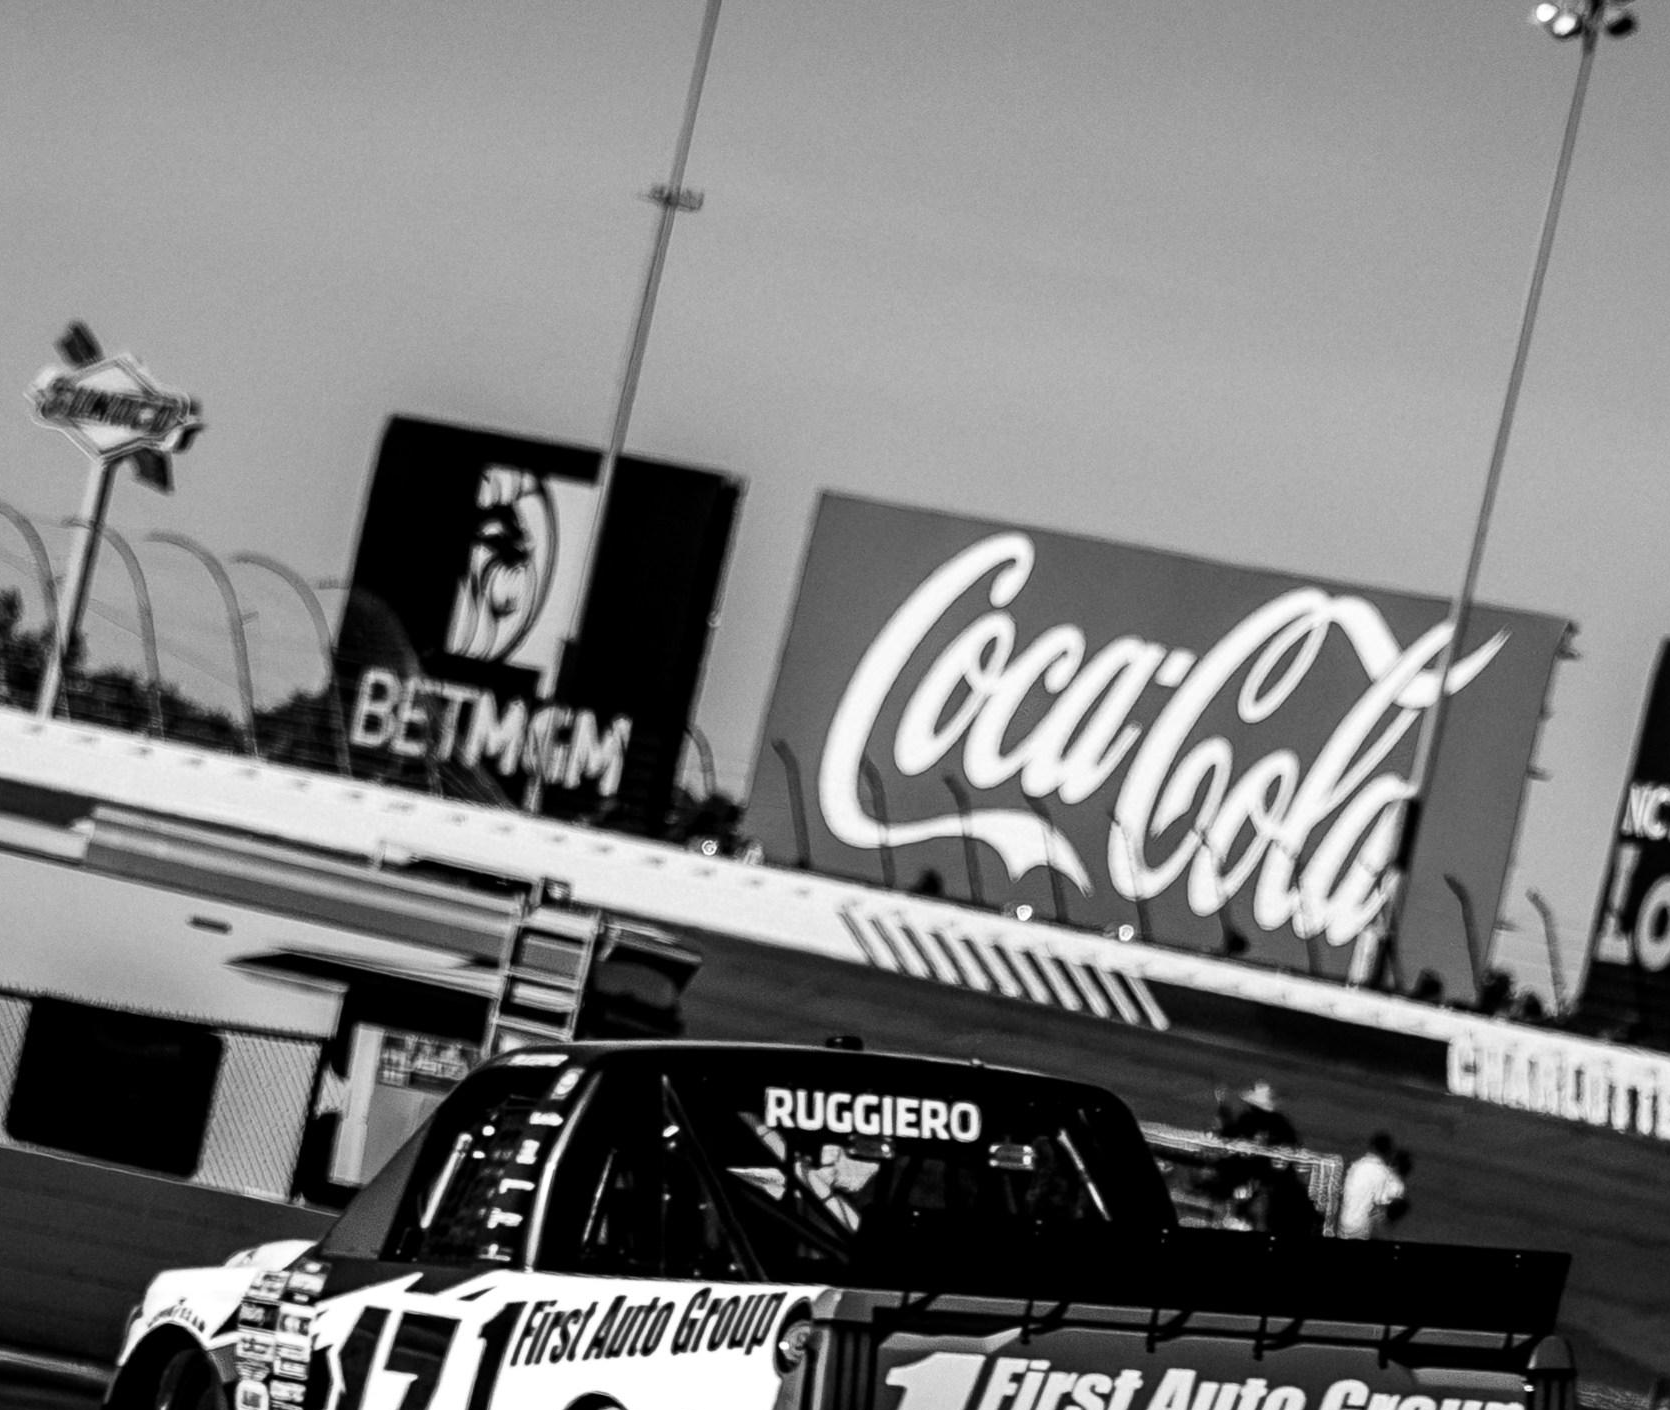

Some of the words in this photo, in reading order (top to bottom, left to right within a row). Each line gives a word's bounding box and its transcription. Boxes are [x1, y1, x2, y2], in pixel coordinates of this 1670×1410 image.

[349, 667, 633, 797] BETMGM
[817, 530, 1513, 948] Coca-Cola
[765, 1086, 980, 1143] RUGGIERO
[511, 1301, 600, 1367] First
[584, 1296, 676, 1361] Auto
[671, 1287, 788, 1356] Group
